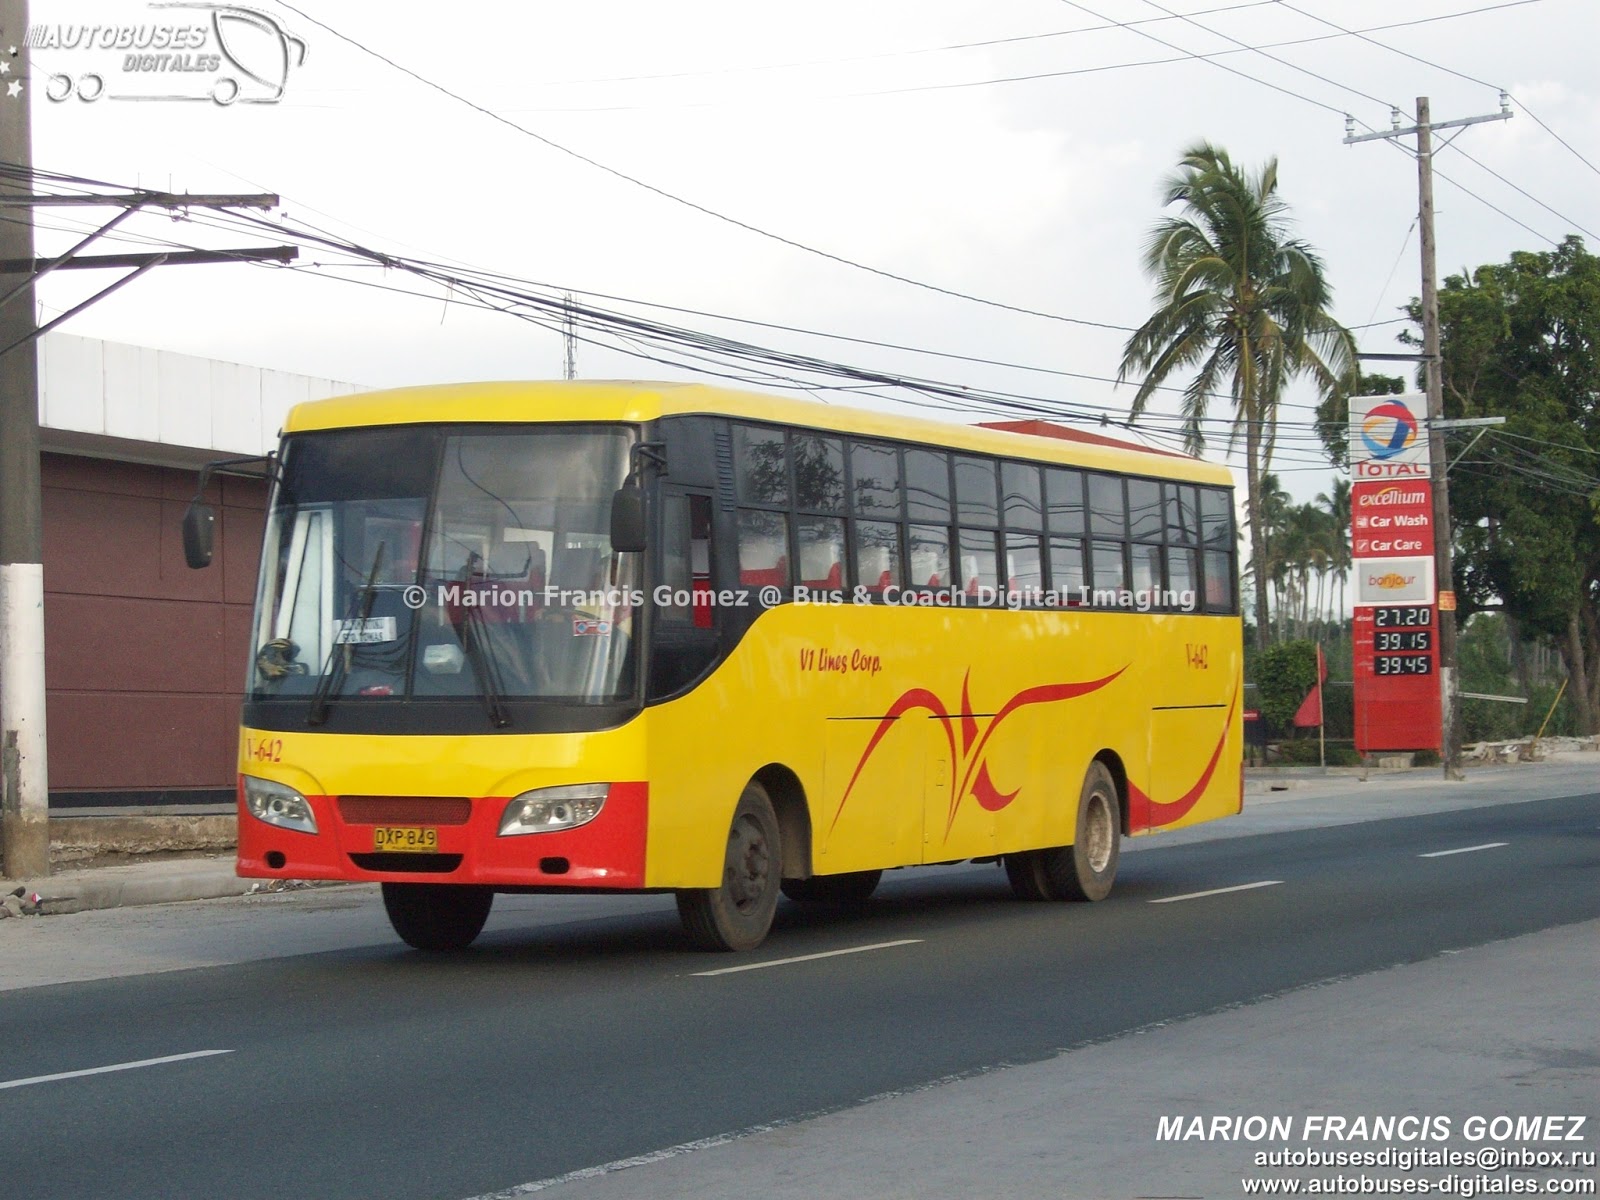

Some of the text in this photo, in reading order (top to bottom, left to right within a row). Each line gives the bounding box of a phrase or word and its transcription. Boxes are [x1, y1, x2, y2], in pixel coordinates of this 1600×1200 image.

[1357, 460, 1427, 476] TOTAL
[1359, 490, 1425, 506] excellium
[1370, 514, 1428, 527] Car Wash
[1370, 539, 1423, 551] Car Care
[1368, 574, 1416, 588] bonjour
[1376, 608, 1430, 626] 27.20
[1379, 633, 1427, 651] 39.15
[801, 648, 882, 677] V1 Lines Corp.
[1379, 656, 1428, 674] 39.45
